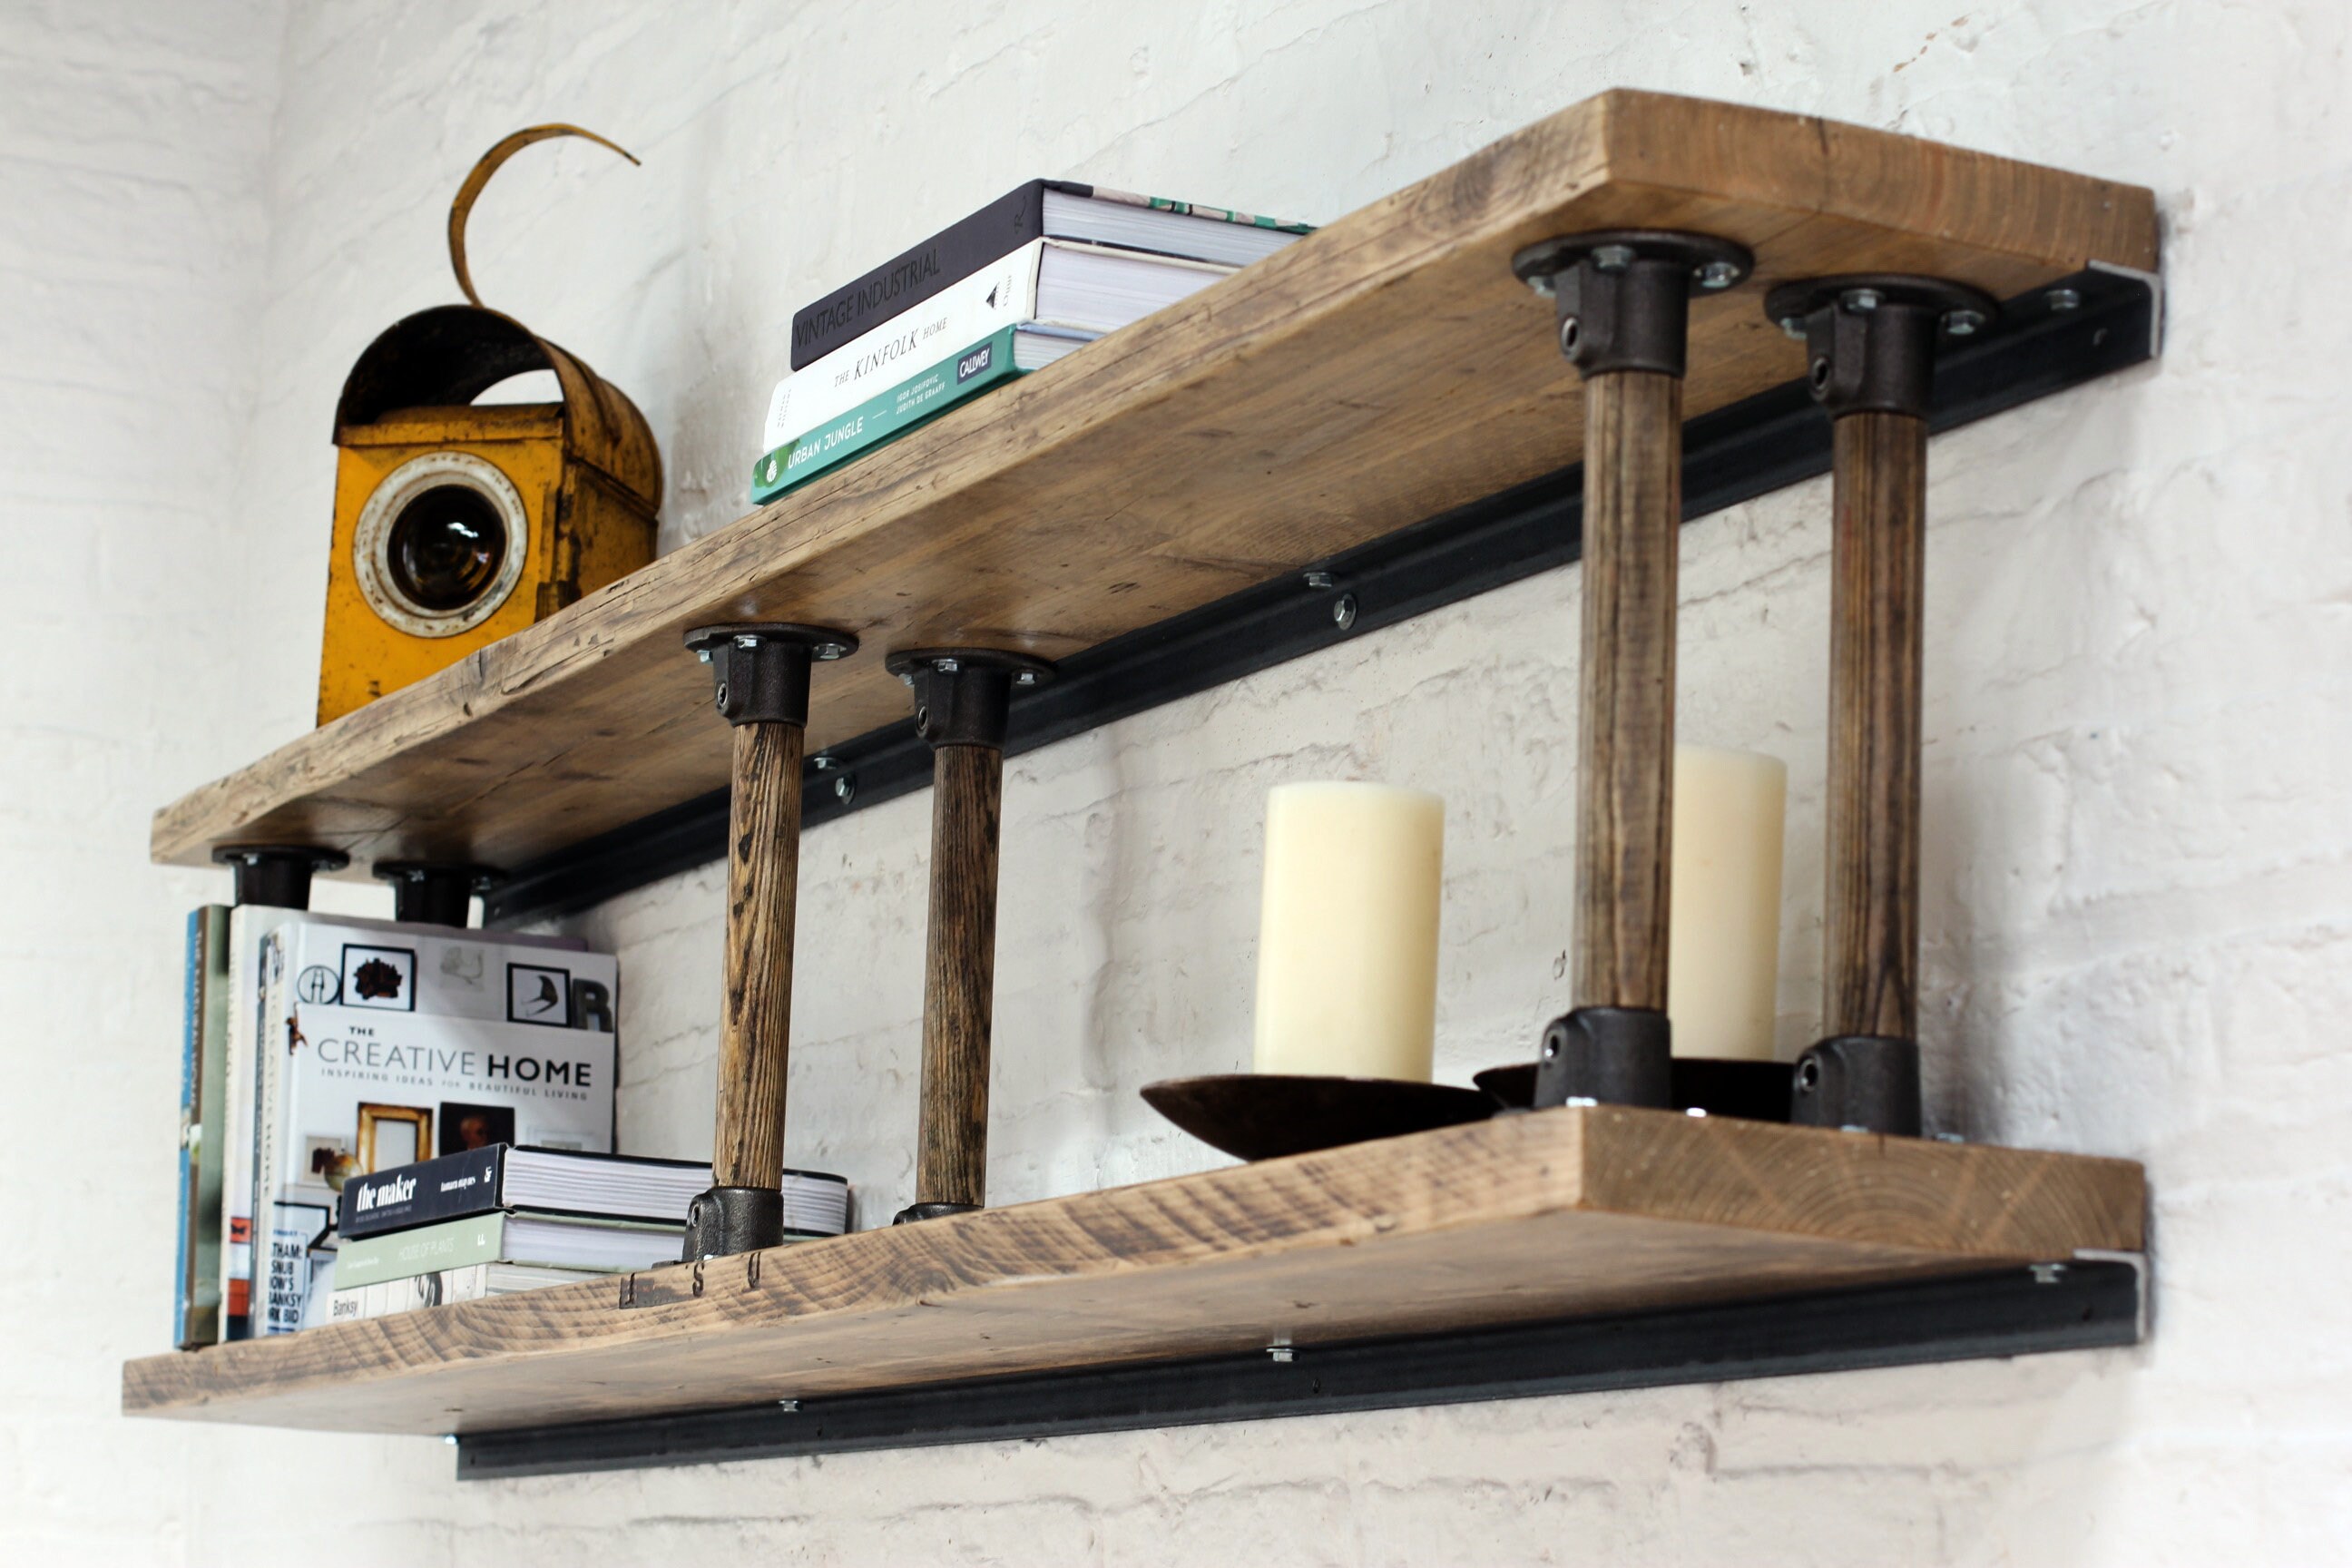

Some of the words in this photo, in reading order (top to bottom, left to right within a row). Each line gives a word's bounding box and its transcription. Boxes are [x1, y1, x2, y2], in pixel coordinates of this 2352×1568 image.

[797, 295, 856, 348] VINTAGE
[858, 249, 941, 317] INDUSTRIAL
[835, 369, 850, 387] THE
[853, 328, 919, 380] KINFOLK
[922, 318, 948, 340] HOME
[959, 348, 990, 378] CALLWEY
[896, 398, 916, 415] JUDITH
[788, 439, 820, 469] URBAN
[824, 416, 864, 451] JUNGLE
[572, 978, 613, 1033] R
[349, 1026, 375, 1036] THE
[318, 1038, 475, 1076] CREATIVE
[488, 1054, 592, 1087] HOME
[321, 1068, 388, 1082] INSPIRING
[396, 1075, 433, 1086] IDEAS
[442, 1079, 460, 1088] FOR
[469, 1083, 537, 1096] BEAUTIFUL
[544, 1090, 588, 1101] LIVING
[357, 1181, 377, 1212] the
[377, 1173, 416, 1208] maker
[333, 1298, 358, 1317] Banksy
